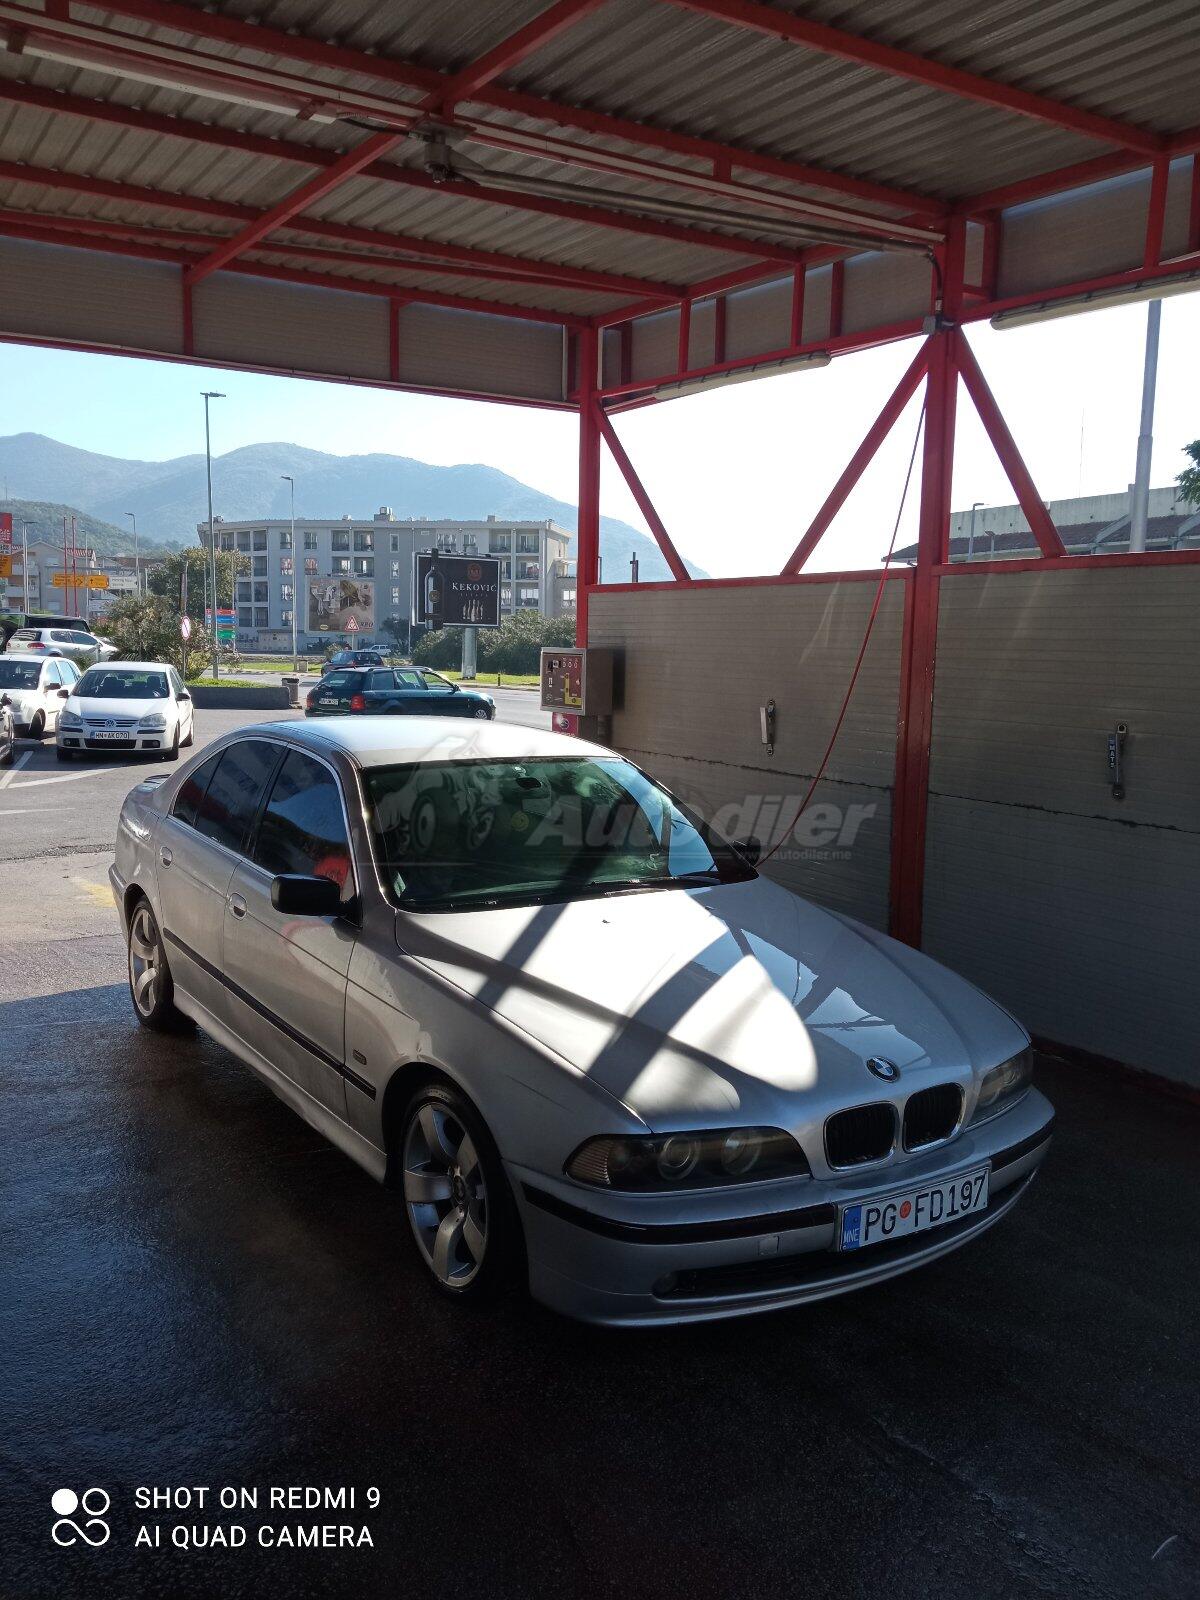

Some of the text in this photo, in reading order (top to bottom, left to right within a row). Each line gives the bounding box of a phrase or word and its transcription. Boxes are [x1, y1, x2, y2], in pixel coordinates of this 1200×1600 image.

[864, 1173, 986, 1241] PG FD197
[843, 1227, 860, 1243] MNE
